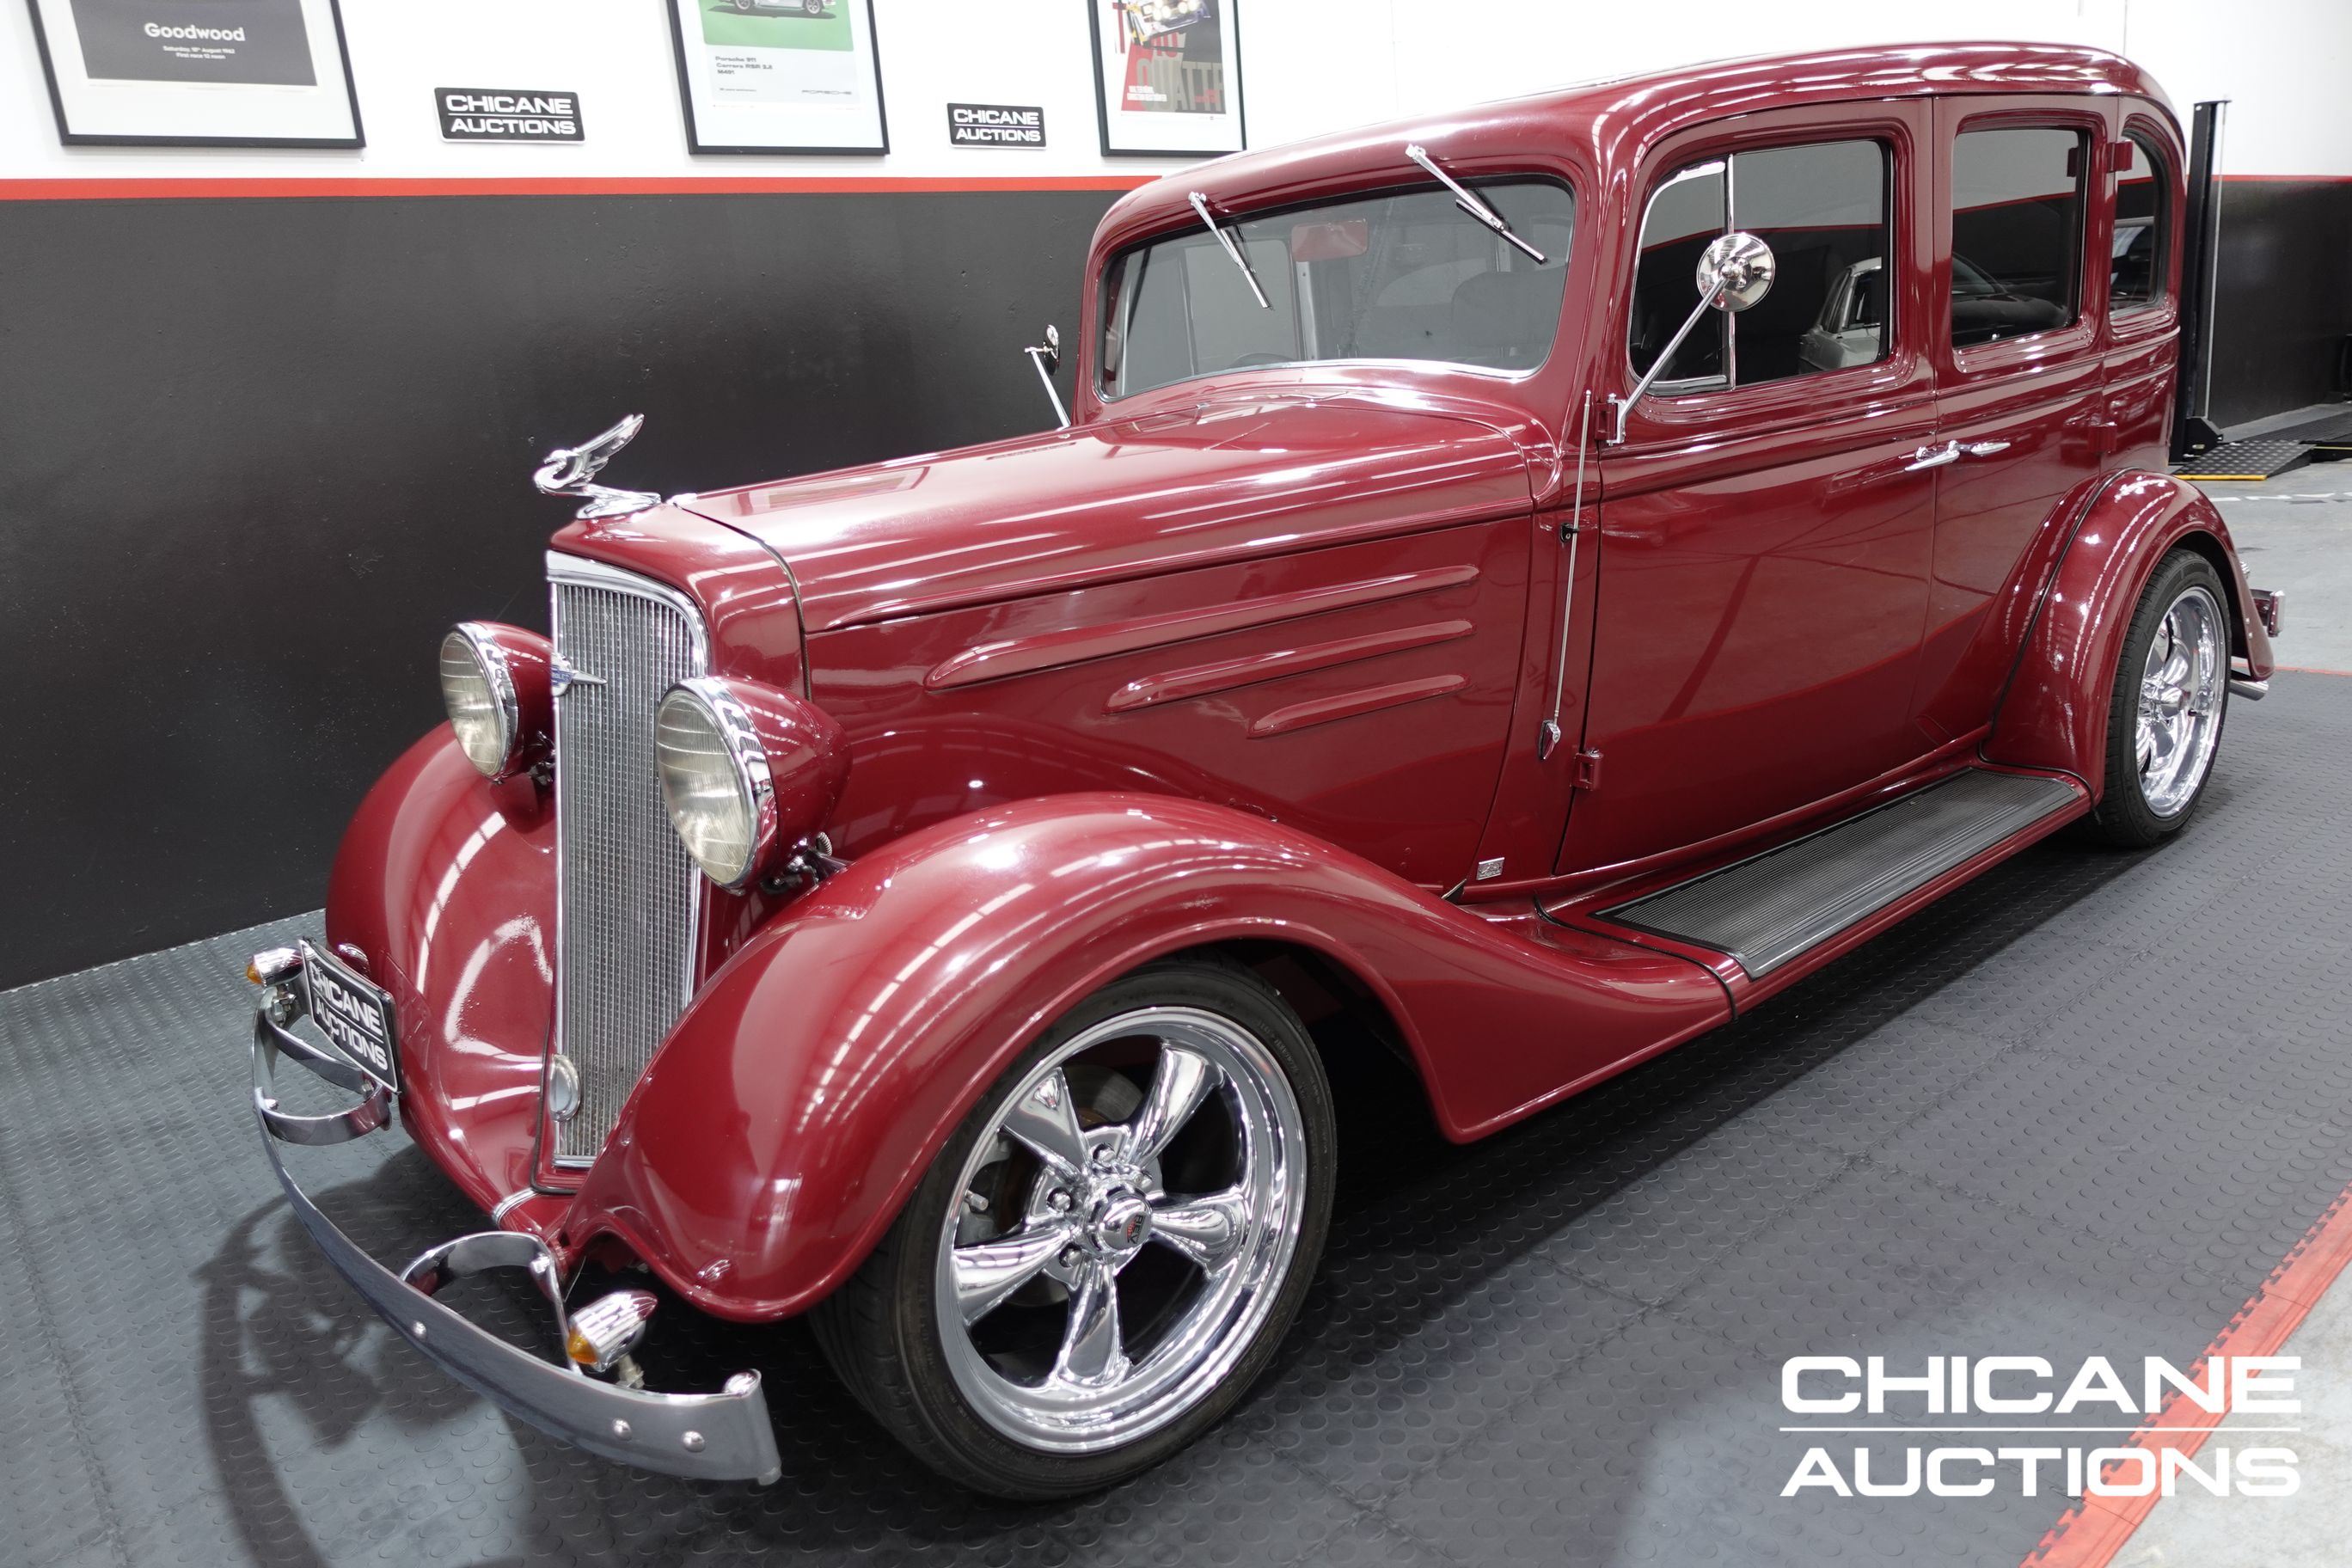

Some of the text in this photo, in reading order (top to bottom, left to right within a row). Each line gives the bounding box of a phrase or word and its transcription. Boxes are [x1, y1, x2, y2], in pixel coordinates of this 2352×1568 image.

[144, 22, 246, 41] Goodwood
[445, 95, 573, 114] CHICANE
[953, 108, 1040, 126] CHICANE
[450, 119, 577, 135] AUCTIONS
[956, 127, 1042, 142] AUCTIONS
[309, 960, 383, 1037] CHICANE
[315, 997, 389, 1071] AUCTIONS
